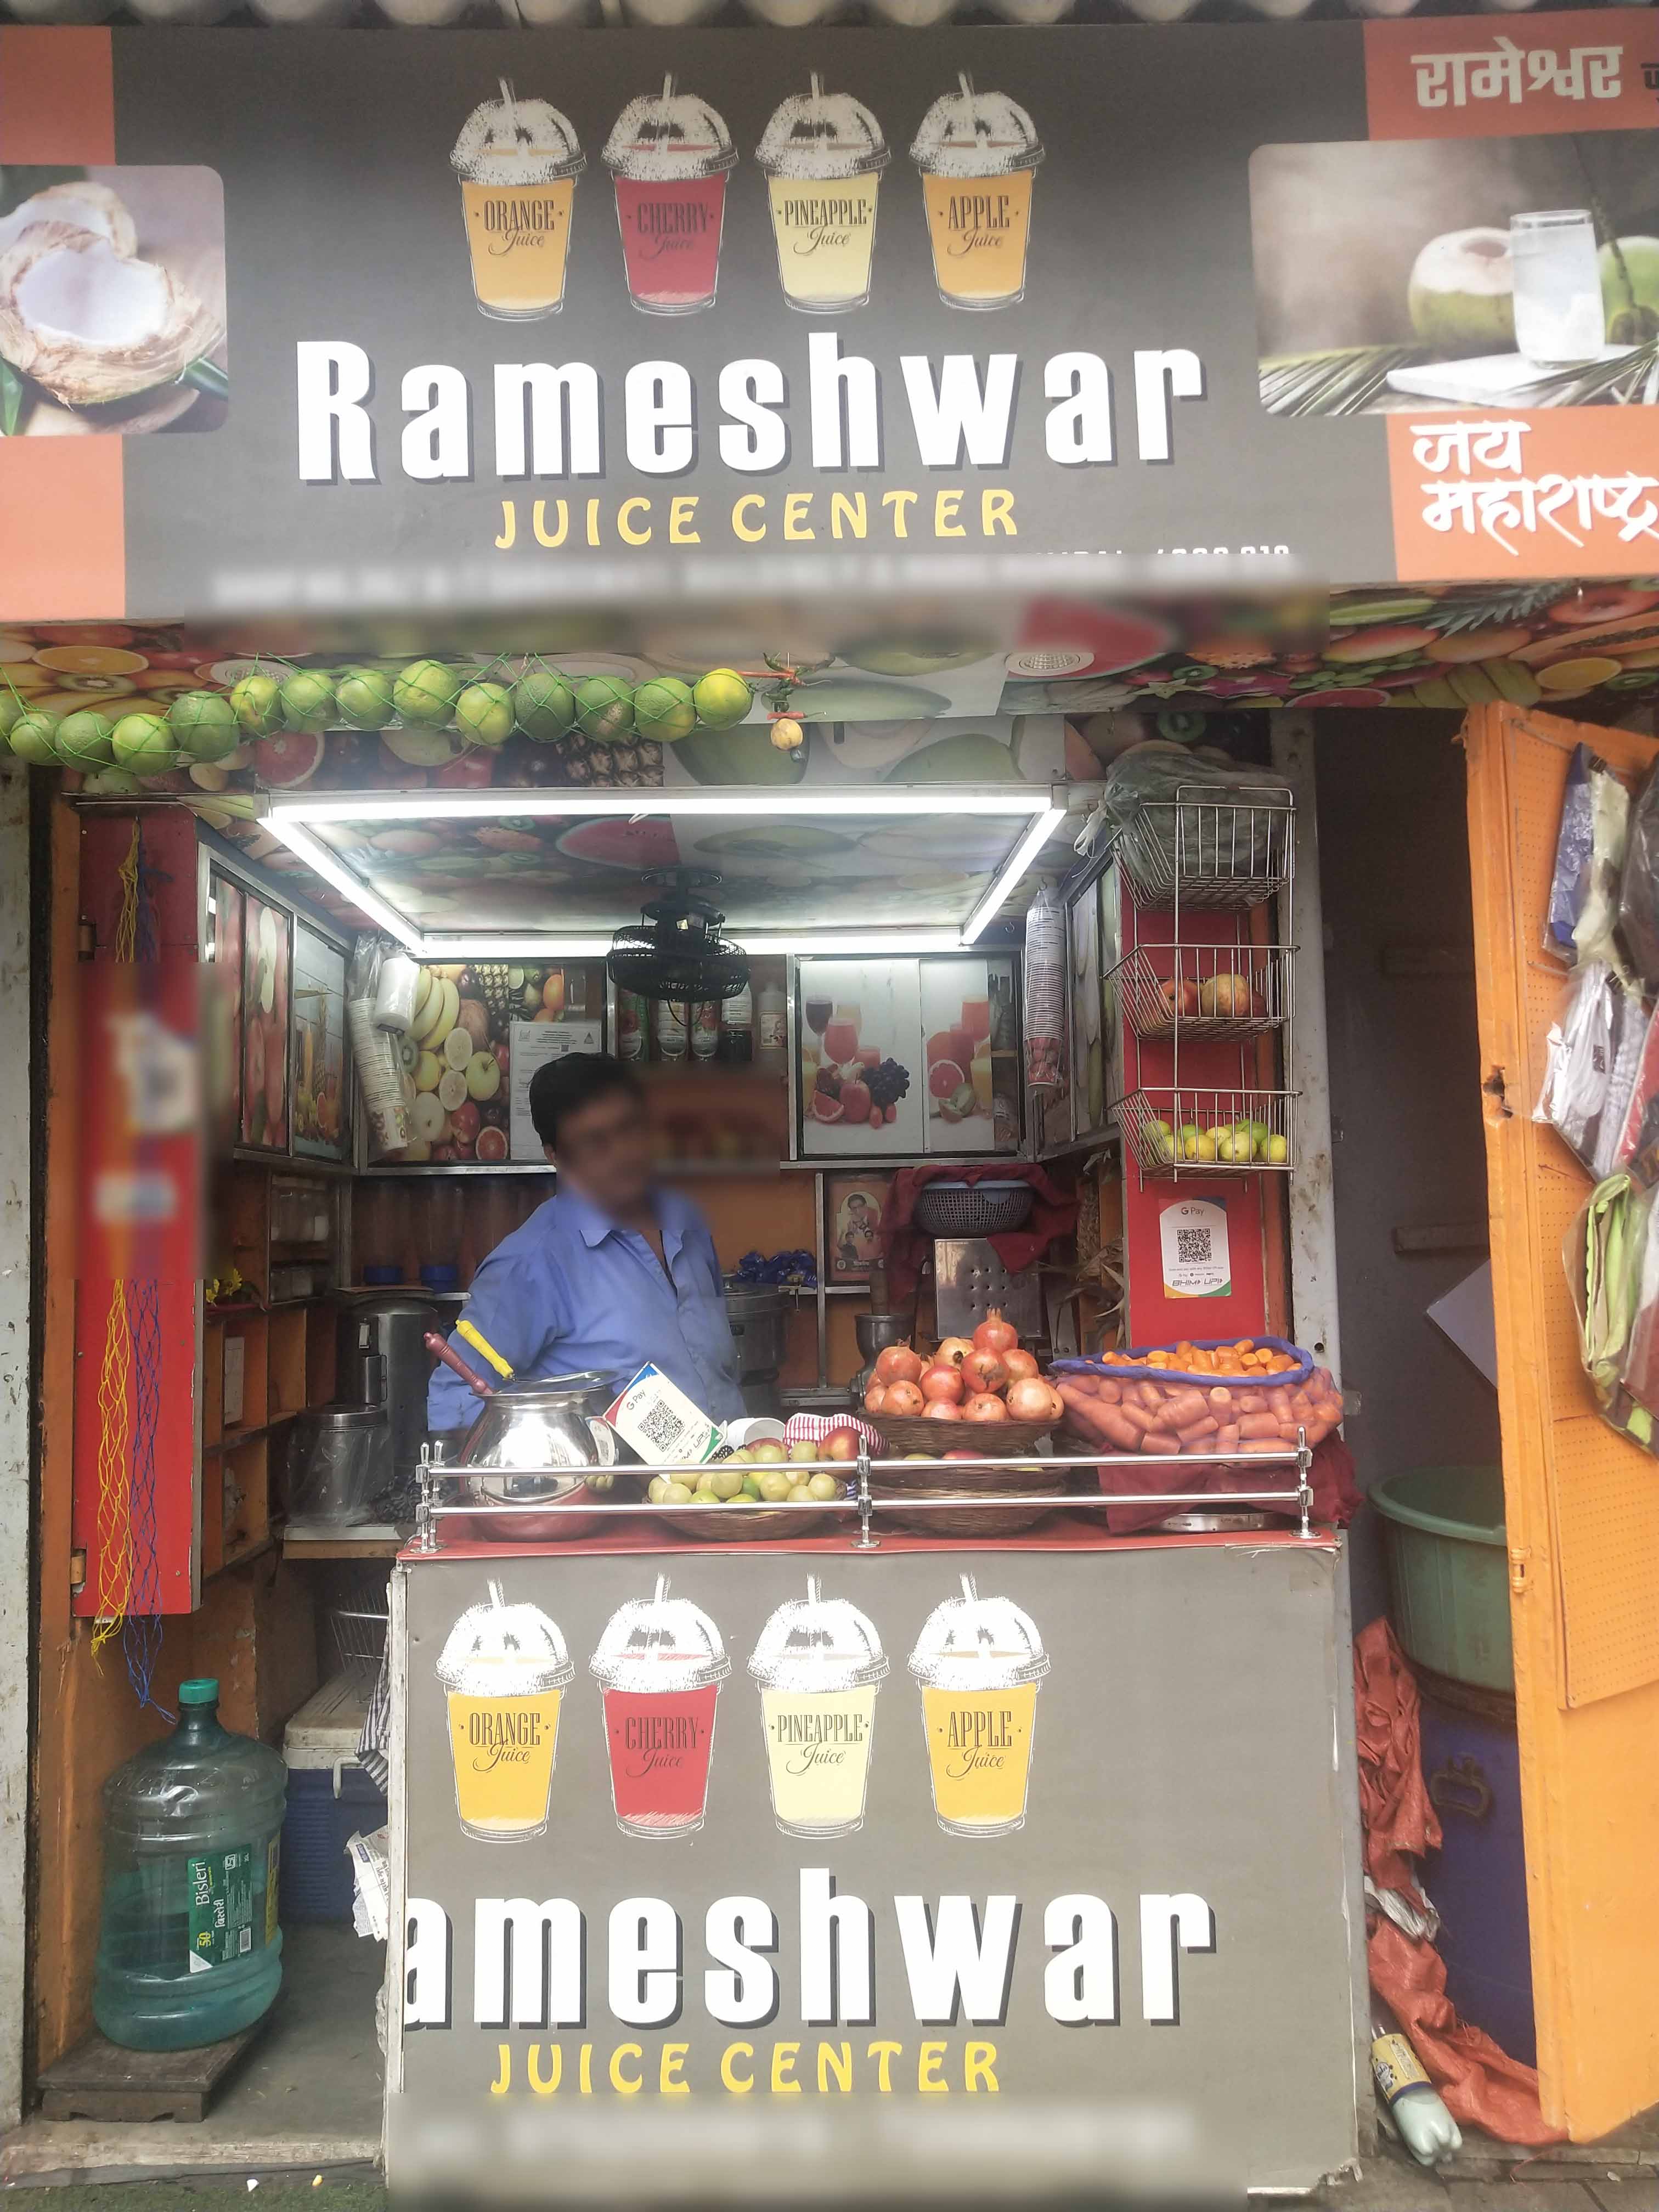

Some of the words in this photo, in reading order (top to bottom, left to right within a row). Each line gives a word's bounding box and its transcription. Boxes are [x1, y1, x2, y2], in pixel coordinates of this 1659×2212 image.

[1410, 36, 1623, 107] रामेश्वर
[483, 199, 555, 232] ORANGE
[636, 201, 709, 234] CHERRY
[784, 199, 867, 227] PINEAPPLE
[947, 195, 1011, 229] APPLE
[488, 226, 545, 256] Juice
[639, 233, 695, 260] Juice
[793, 225, 851, 257] Juice
[946, 227, 1004, 257] Juice
[297, 331, 1207, 485] Rameshwar
[1409, 419, 1532, 475] जय
[494, 496, 701, 549] JUICE
[731, 489, 1018, 541] CENTER
[1420, 471, 1659, 556] महाराष्ट्र
[1190, 1207, 1205, 1216] Pay
[626, 1402, 635, 1410] G
[633, 1390, 646, 1403] Pay
[469, 1712, 541, 1746] ORANGE
[624, 1716, 699, 1750] CHERRY
[777, 1713, 864, 1742] PINEAPPLE
[947, 1711, 1013, 1747] APPLE
[472, 1739, 531, 1773] Juice
[625, 1746, 684, 1778] Juice
[785, 1741, 847, 1775] Juice
[945, 1746, 1007, 1780] Juice
[193, 1861, 210, 1906] Bisleri
[199, 1931, 211, 1947] 50
[490, 2042, 691, 2092] JUICE
[720, 2041, 1000, 2092] CENTER
